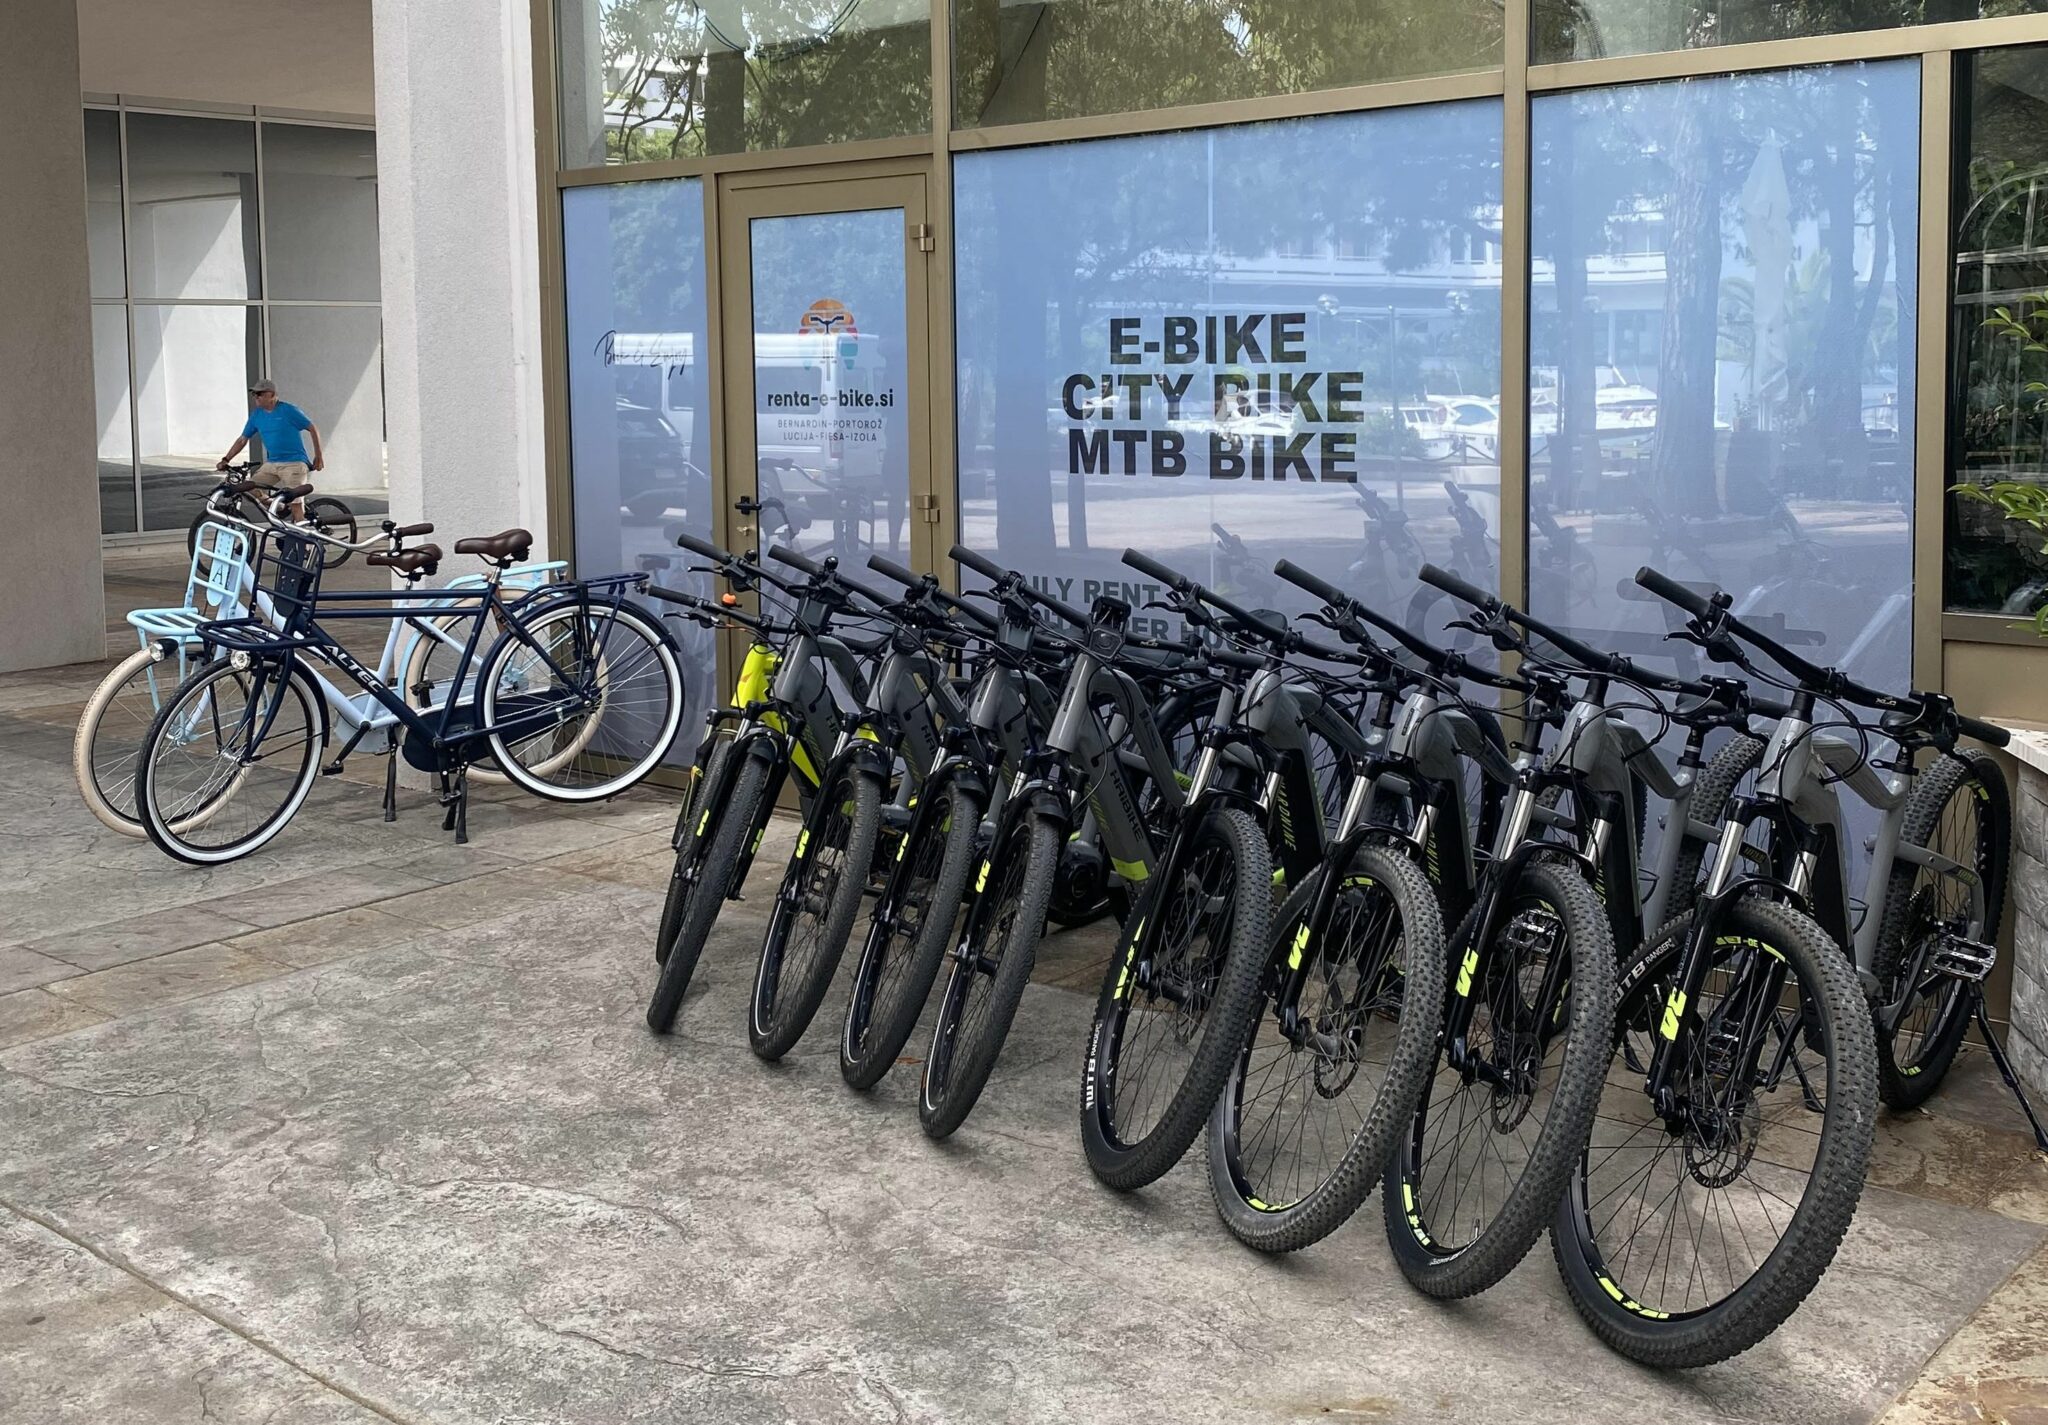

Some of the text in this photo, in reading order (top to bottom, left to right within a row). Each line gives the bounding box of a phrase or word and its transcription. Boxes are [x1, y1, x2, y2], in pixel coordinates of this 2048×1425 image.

[1110, 312, 1307, 365] E-BIKE
[767, 388, 894, 407] renta-e-bike.si
[1062, 371, 1365, 423] CITY BIKE
[778, 418, 883, 430] BERNARDIN-PORTOROŽ
[1068, 428, 1358, 484] MTB BIKE
[1083, 579, 1161, 609] RENT
[322, 644, 384, 693] ALTEC
